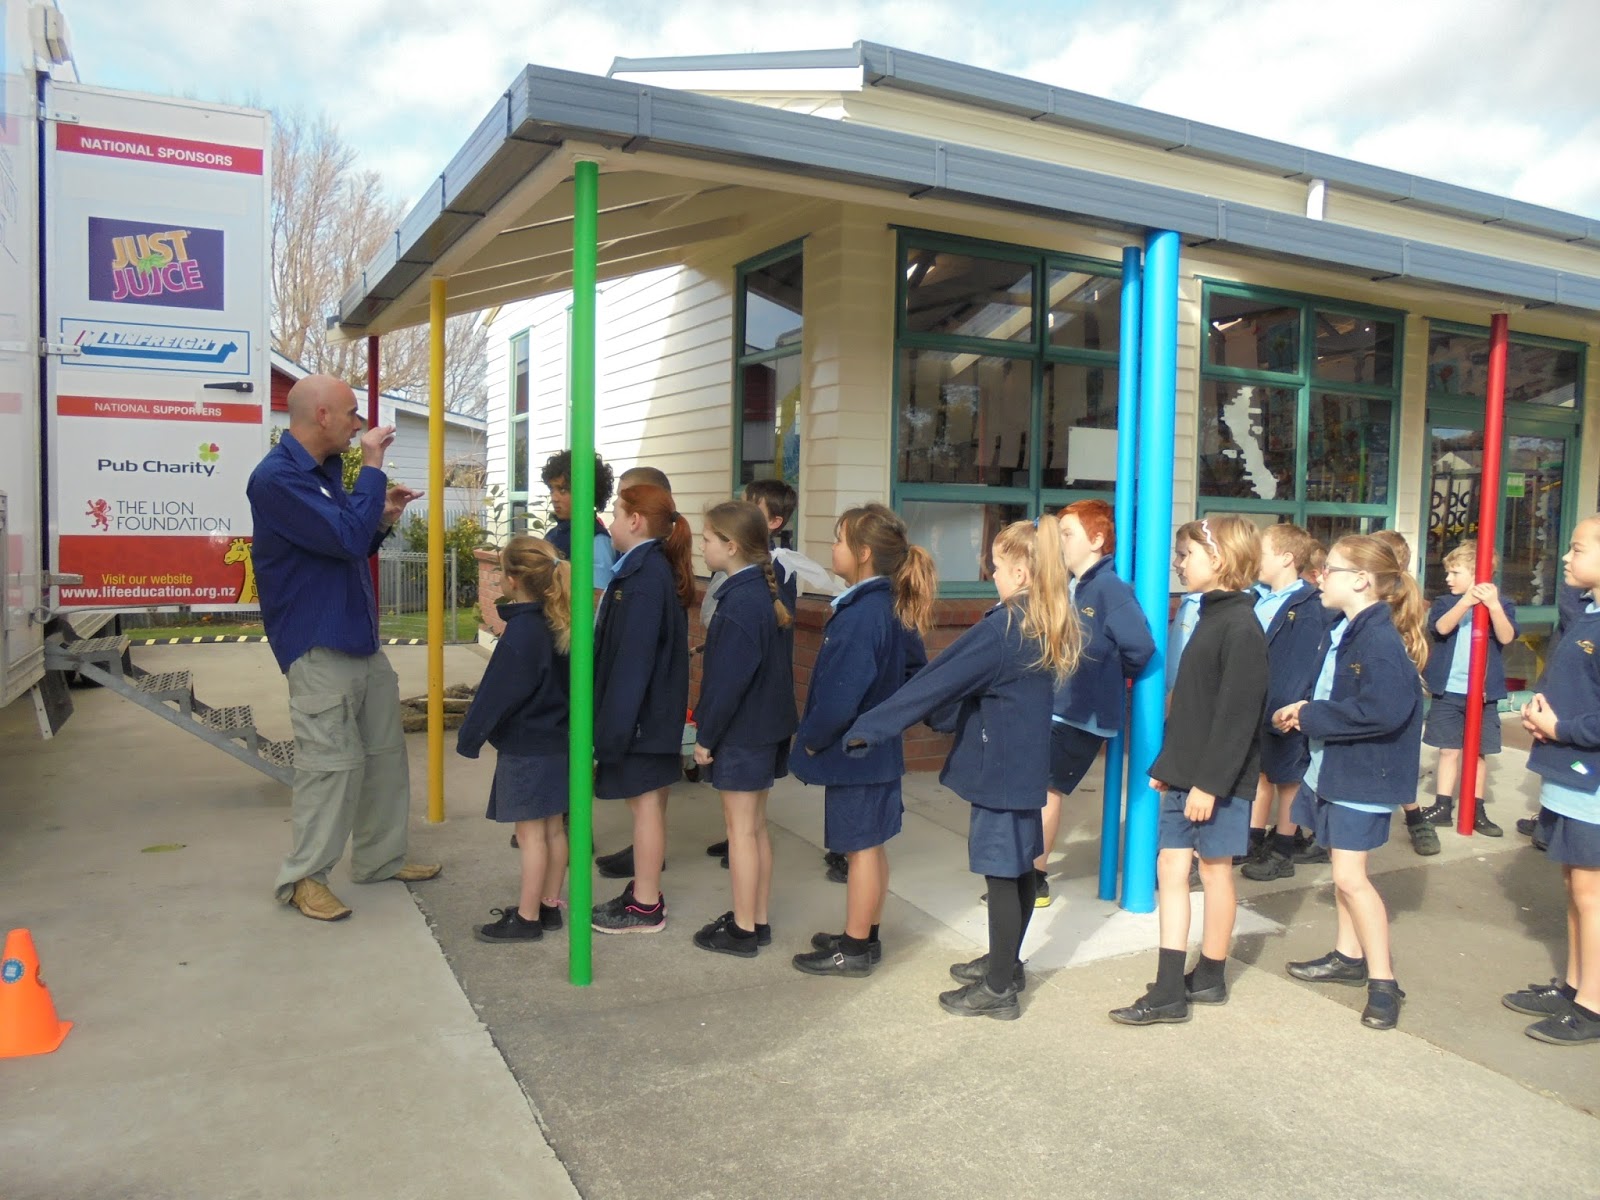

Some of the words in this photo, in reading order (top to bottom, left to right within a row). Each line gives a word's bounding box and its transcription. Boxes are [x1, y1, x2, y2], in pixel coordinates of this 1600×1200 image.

[80, 136, 154, 157] NATIONAL
[157, 147, 233, 167] SPONSORS
[111, 229, 189, 270] JUST
[112, 259, 204, 300] JUICE
[94, 402, 150, 413] NATIONAL
[98, 459, 138, 472] Pub
[142, 460, 215, 477] Charity
[117, 500, 148, 515] THE
[152, 501, 194, 515] LION
[117, 516, 231, 531] FOUNDATION
[102, 574, 126, 585] Visit
[128, 576, 147, 585] our
[150, 574, 192, 585] website
[61, 586, 236, 598] www.lifeeducation.org.nz
